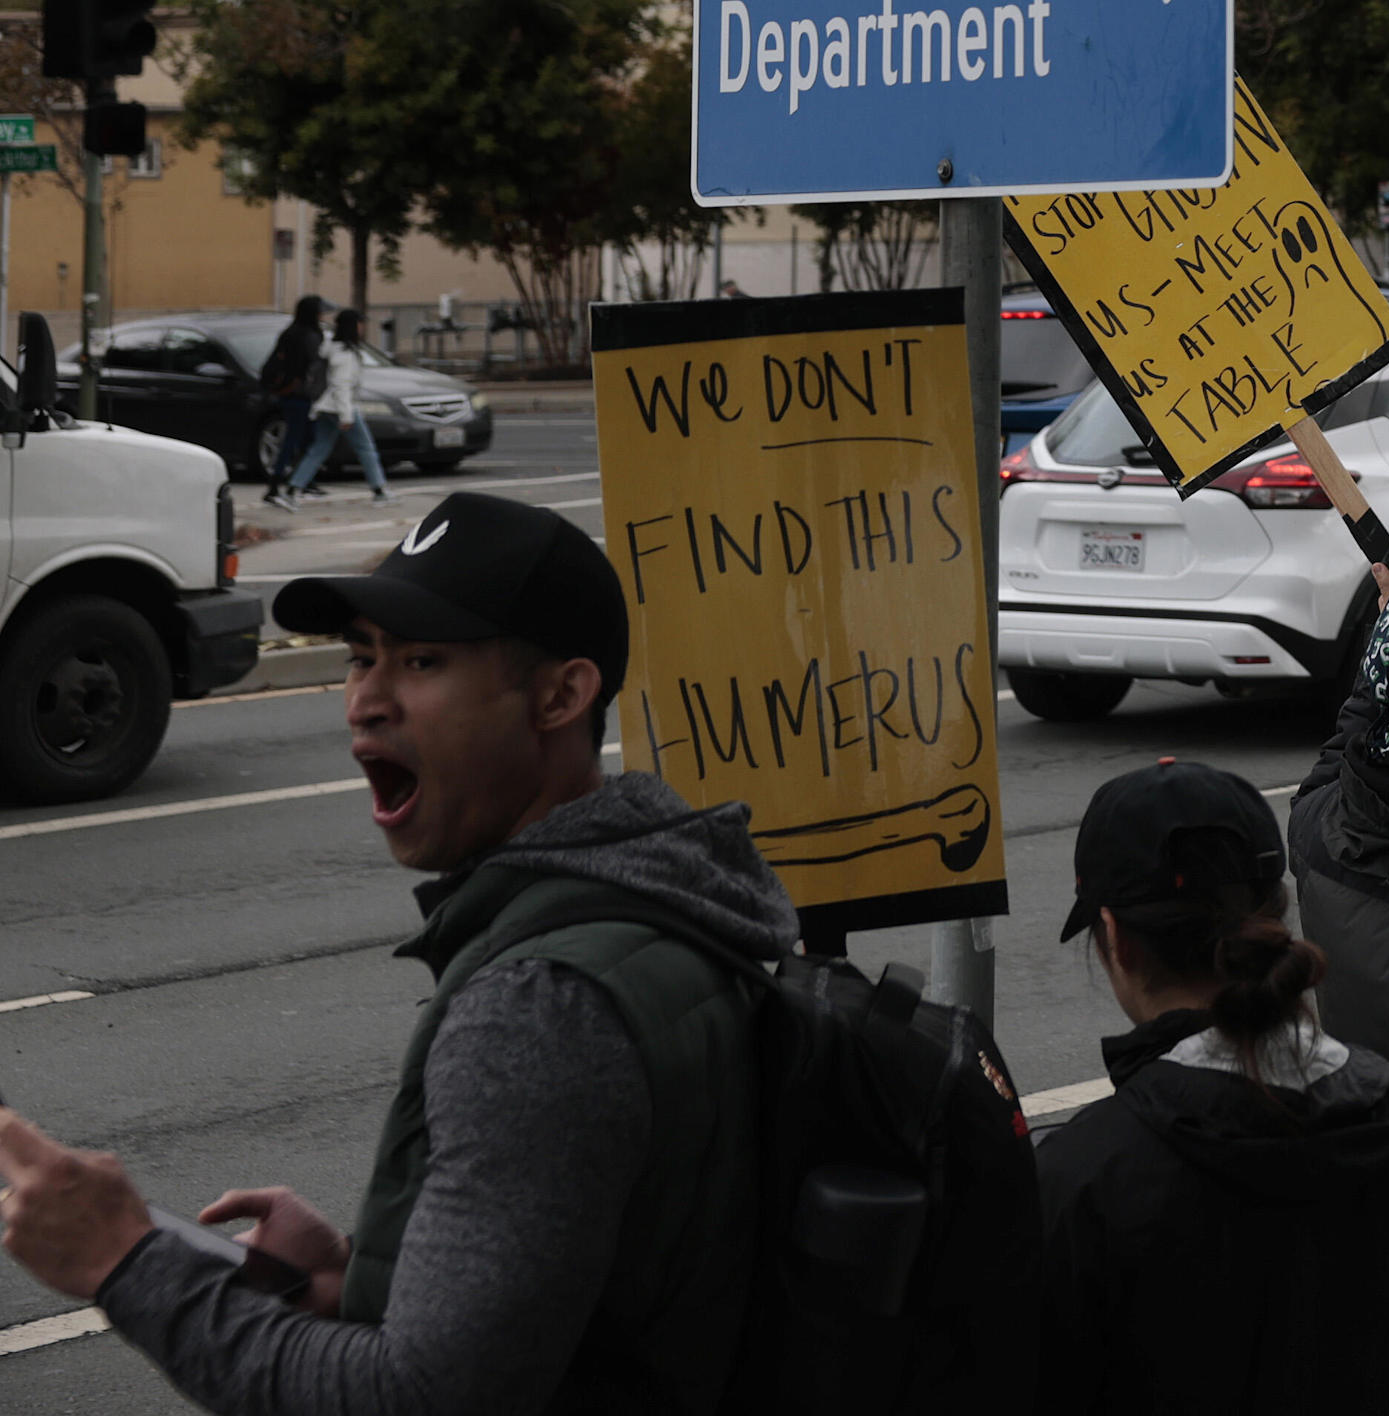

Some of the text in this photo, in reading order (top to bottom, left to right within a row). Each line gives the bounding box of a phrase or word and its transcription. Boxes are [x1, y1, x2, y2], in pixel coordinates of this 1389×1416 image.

[1178, 314, 1215, 360] AT
[1216, 276, 1278, 327] THE
[763, 338, 922, 426] DON'T
[1165, 323, 1318, 444] TABLE
[626, 484, 964, 604] FIND THIS
[642, 641, 981, 781] HUMERUS
